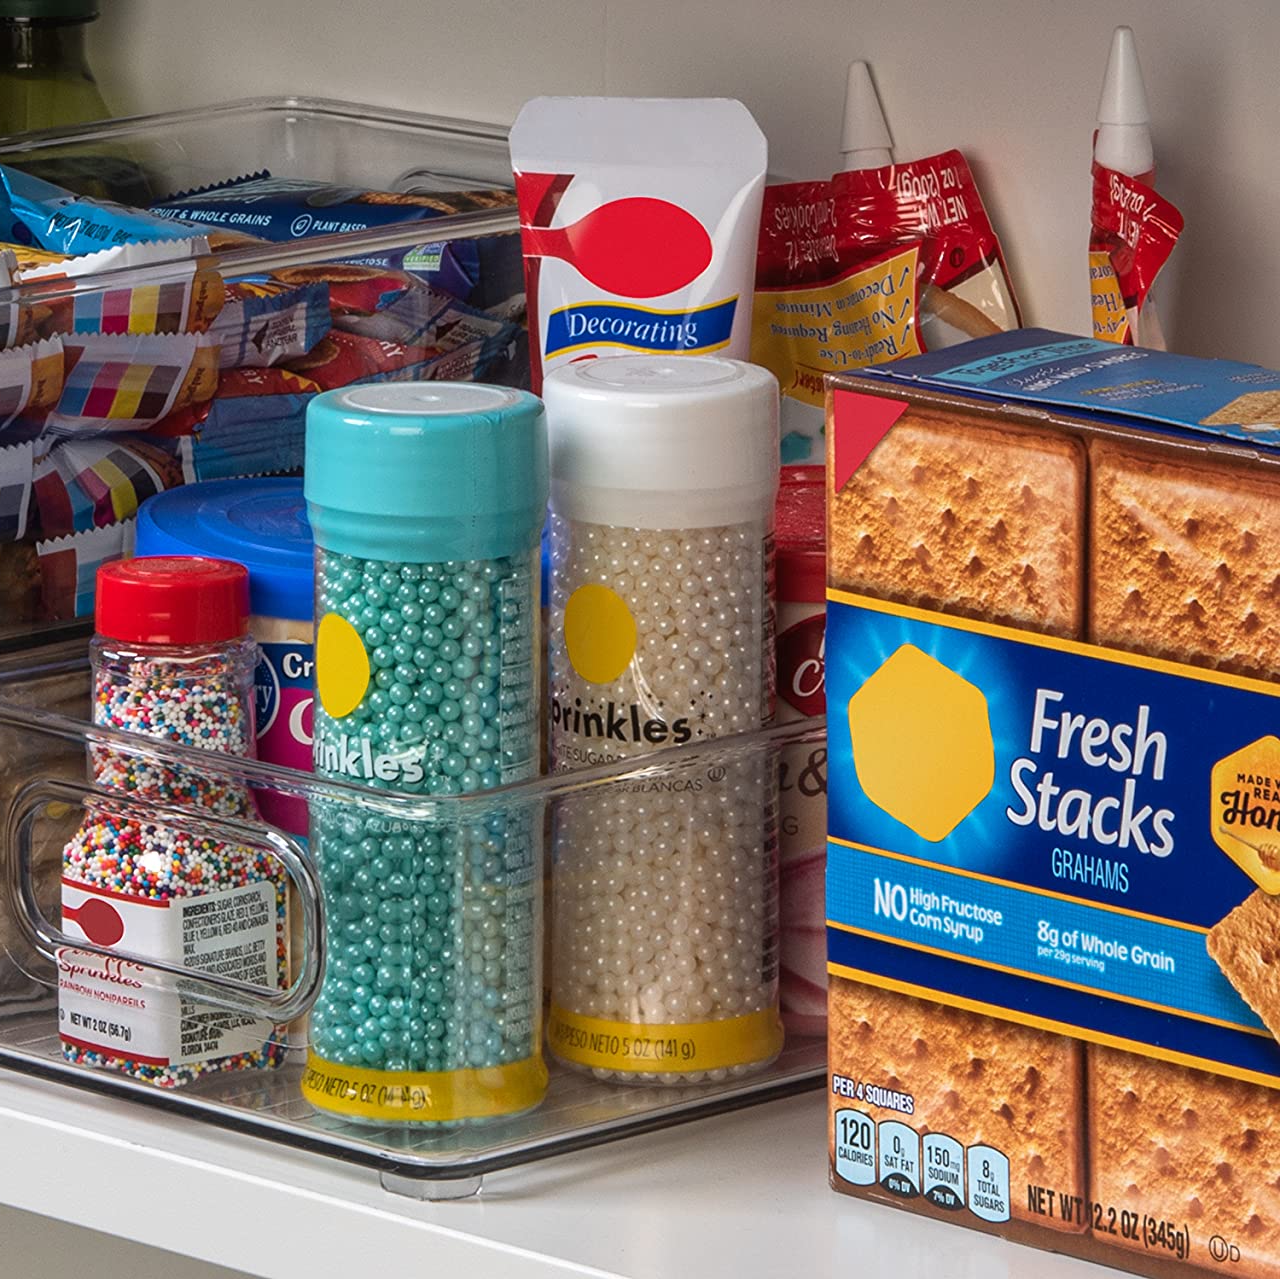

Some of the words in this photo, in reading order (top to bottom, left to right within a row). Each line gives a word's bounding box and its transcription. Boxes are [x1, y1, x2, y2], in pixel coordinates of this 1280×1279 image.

[148, 207, 177, 219] FRUIT
[180, 210, 188, 219] &
[190, 210, 227, 222] WHOLE
[229, 213, 272, 226] GRAINS
[312, 220, 337, 232] PLANT
[570, 313, 698, 347] Decorating
[1030, 688, 1167, 781] Fresh
[1237, 773, 1270, 787] MADE
[1007, 759, 1175, 858] Stacks
[1052, 848, 1129, 893] GRAHAMS
[873, 878, 907, 921] NO
[910, 888, 939, 912] High
[941, 894, 1003, 926] Fructose
[910, 908, 942, 932] Corn
[944, 916, 983, 943] Syrup
[1037, 921, 1058, 947] 8g
[1062, 928, 1079, 948] of
[1081, 932, 1127, 961] Whole
[1131, 944, 1175, 973] Grain
[1037, 945, 1054, 959] per
[1055, 949, 1070, 963] 29g
[1072, 952, 1105, 972] serving
[71, 1012, 82, 1026] NET
[82, 1014, 92, 1028] WT
[94, 1017, 99, 1030] 2
[100, 1018, 107, 1033] OZ
[833, 1076, 854, 1098] PER
[856, 1086, 863, 1100] 4
[866, 1085, 914, 1114] SQUARES
[841, 1118, 870, 1150] 120
[839, 1146, 873, 1167] CALORIES
[884, 1154, 898, 1168] SAT
[901, 1159, 914, 1173] FAT
[929, 1167, 959, 1185] SODIUM
[977, 1180, 1000, 1197] TOTAL
[974, 1195, 1005, 1213] SUGARS
[1028, 1185, 1055, 1217] NET
[1060, 1193, 1082, 1225] WT
[1088, 1199, 1117, 1236] 12.2
[1121, 1210, 1139, 1241] OZ
[1143, 1215, 1189, 1260] (345g)
